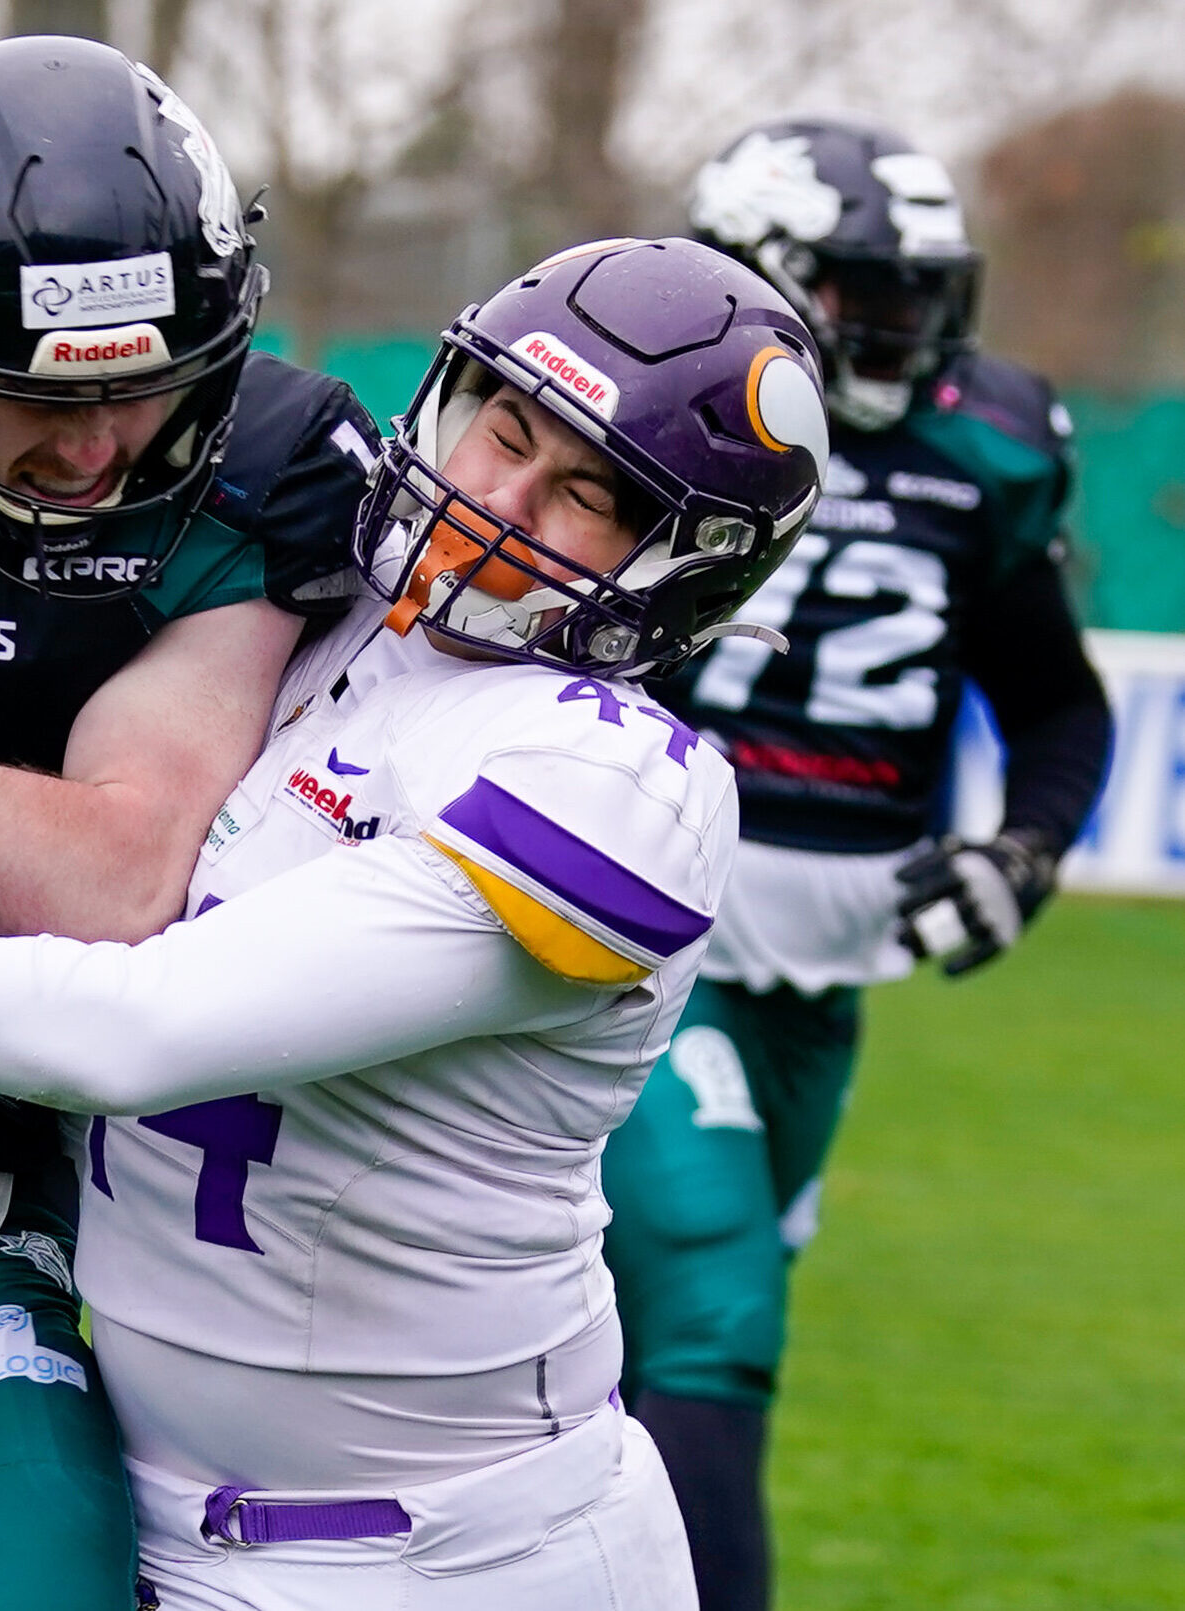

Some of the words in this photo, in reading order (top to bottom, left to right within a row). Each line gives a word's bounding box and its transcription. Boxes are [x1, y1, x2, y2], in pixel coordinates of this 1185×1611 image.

[78, 267, 166, 294] ARTUS
[53, 336, 152, 363] Riddell
[526, 339, 608, 405] Riddell
[557, 678, 699, 771] 44
